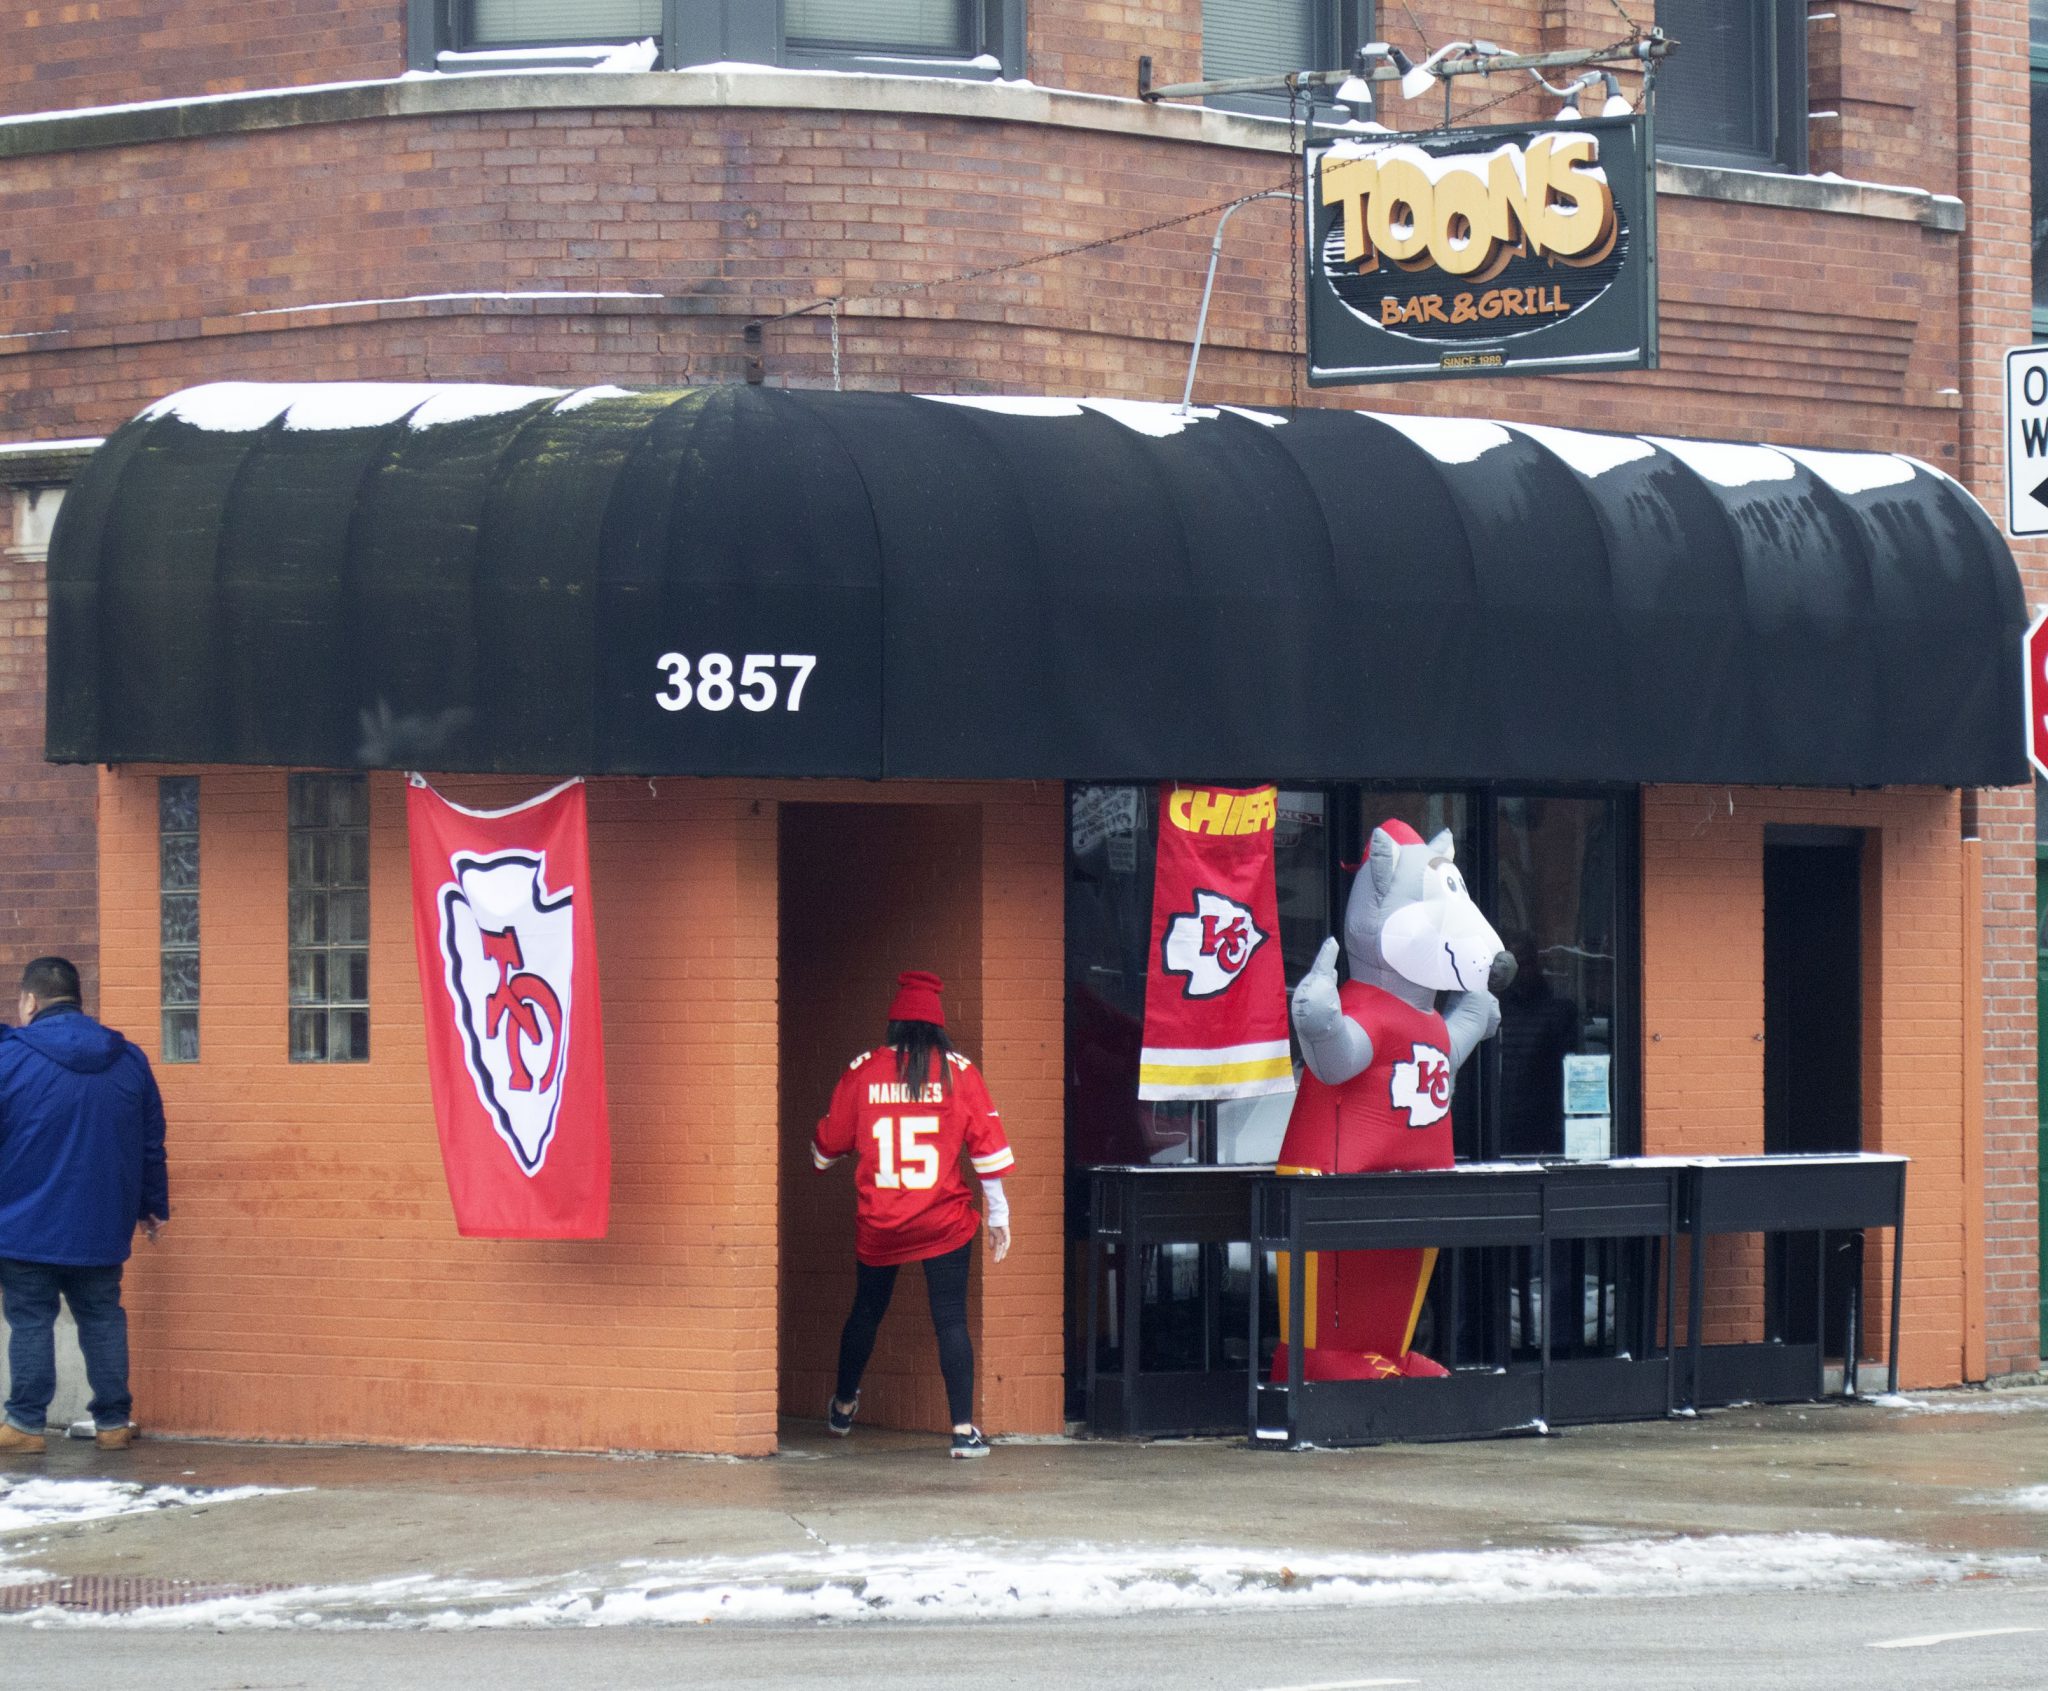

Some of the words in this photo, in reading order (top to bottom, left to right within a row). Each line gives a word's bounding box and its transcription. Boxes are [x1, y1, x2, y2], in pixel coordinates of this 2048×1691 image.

[1321, 136, 1607, 276] TOONS
[1381, 296, 1449, 325] BAR
[1478, 285, 1570, 319] GRILL
[1443, 355, 1475, 367] SINCE
[655, 652, 817, 712] 3857
[1199, 914, 1248, 974] KC
[868, 1083, 943, 1104] MAHOES
[872, 1116, 939, 1190] 15
